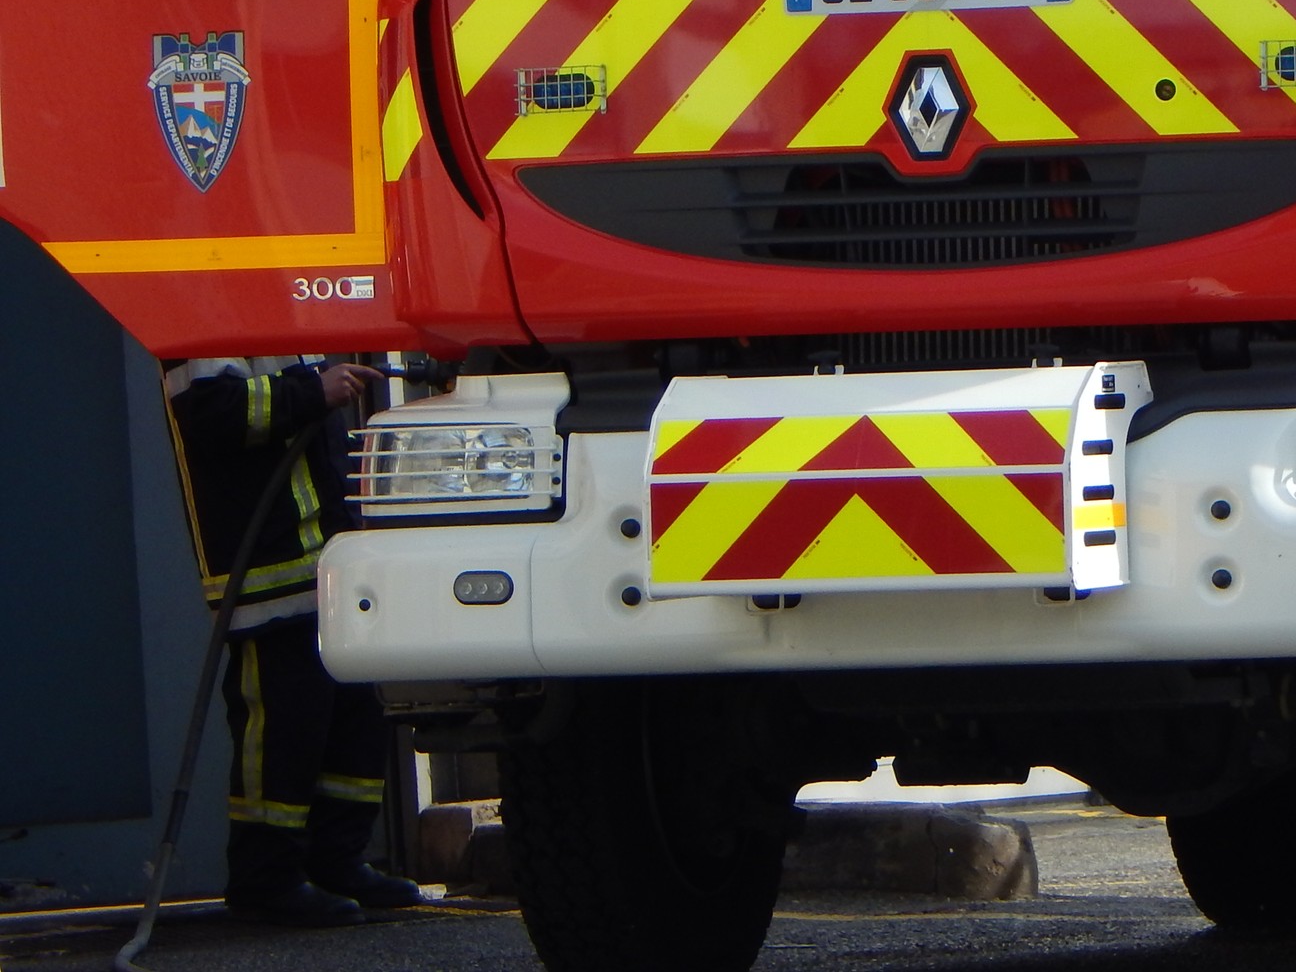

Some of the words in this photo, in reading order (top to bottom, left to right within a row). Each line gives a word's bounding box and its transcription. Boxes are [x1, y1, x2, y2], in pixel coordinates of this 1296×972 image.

[174, 71, 222, 82] SAVOIE
[159, 86, 172, 119] SERVICE
[227, 83, 238, 118] SECOURS
[292, 276, 353, 301] 300
